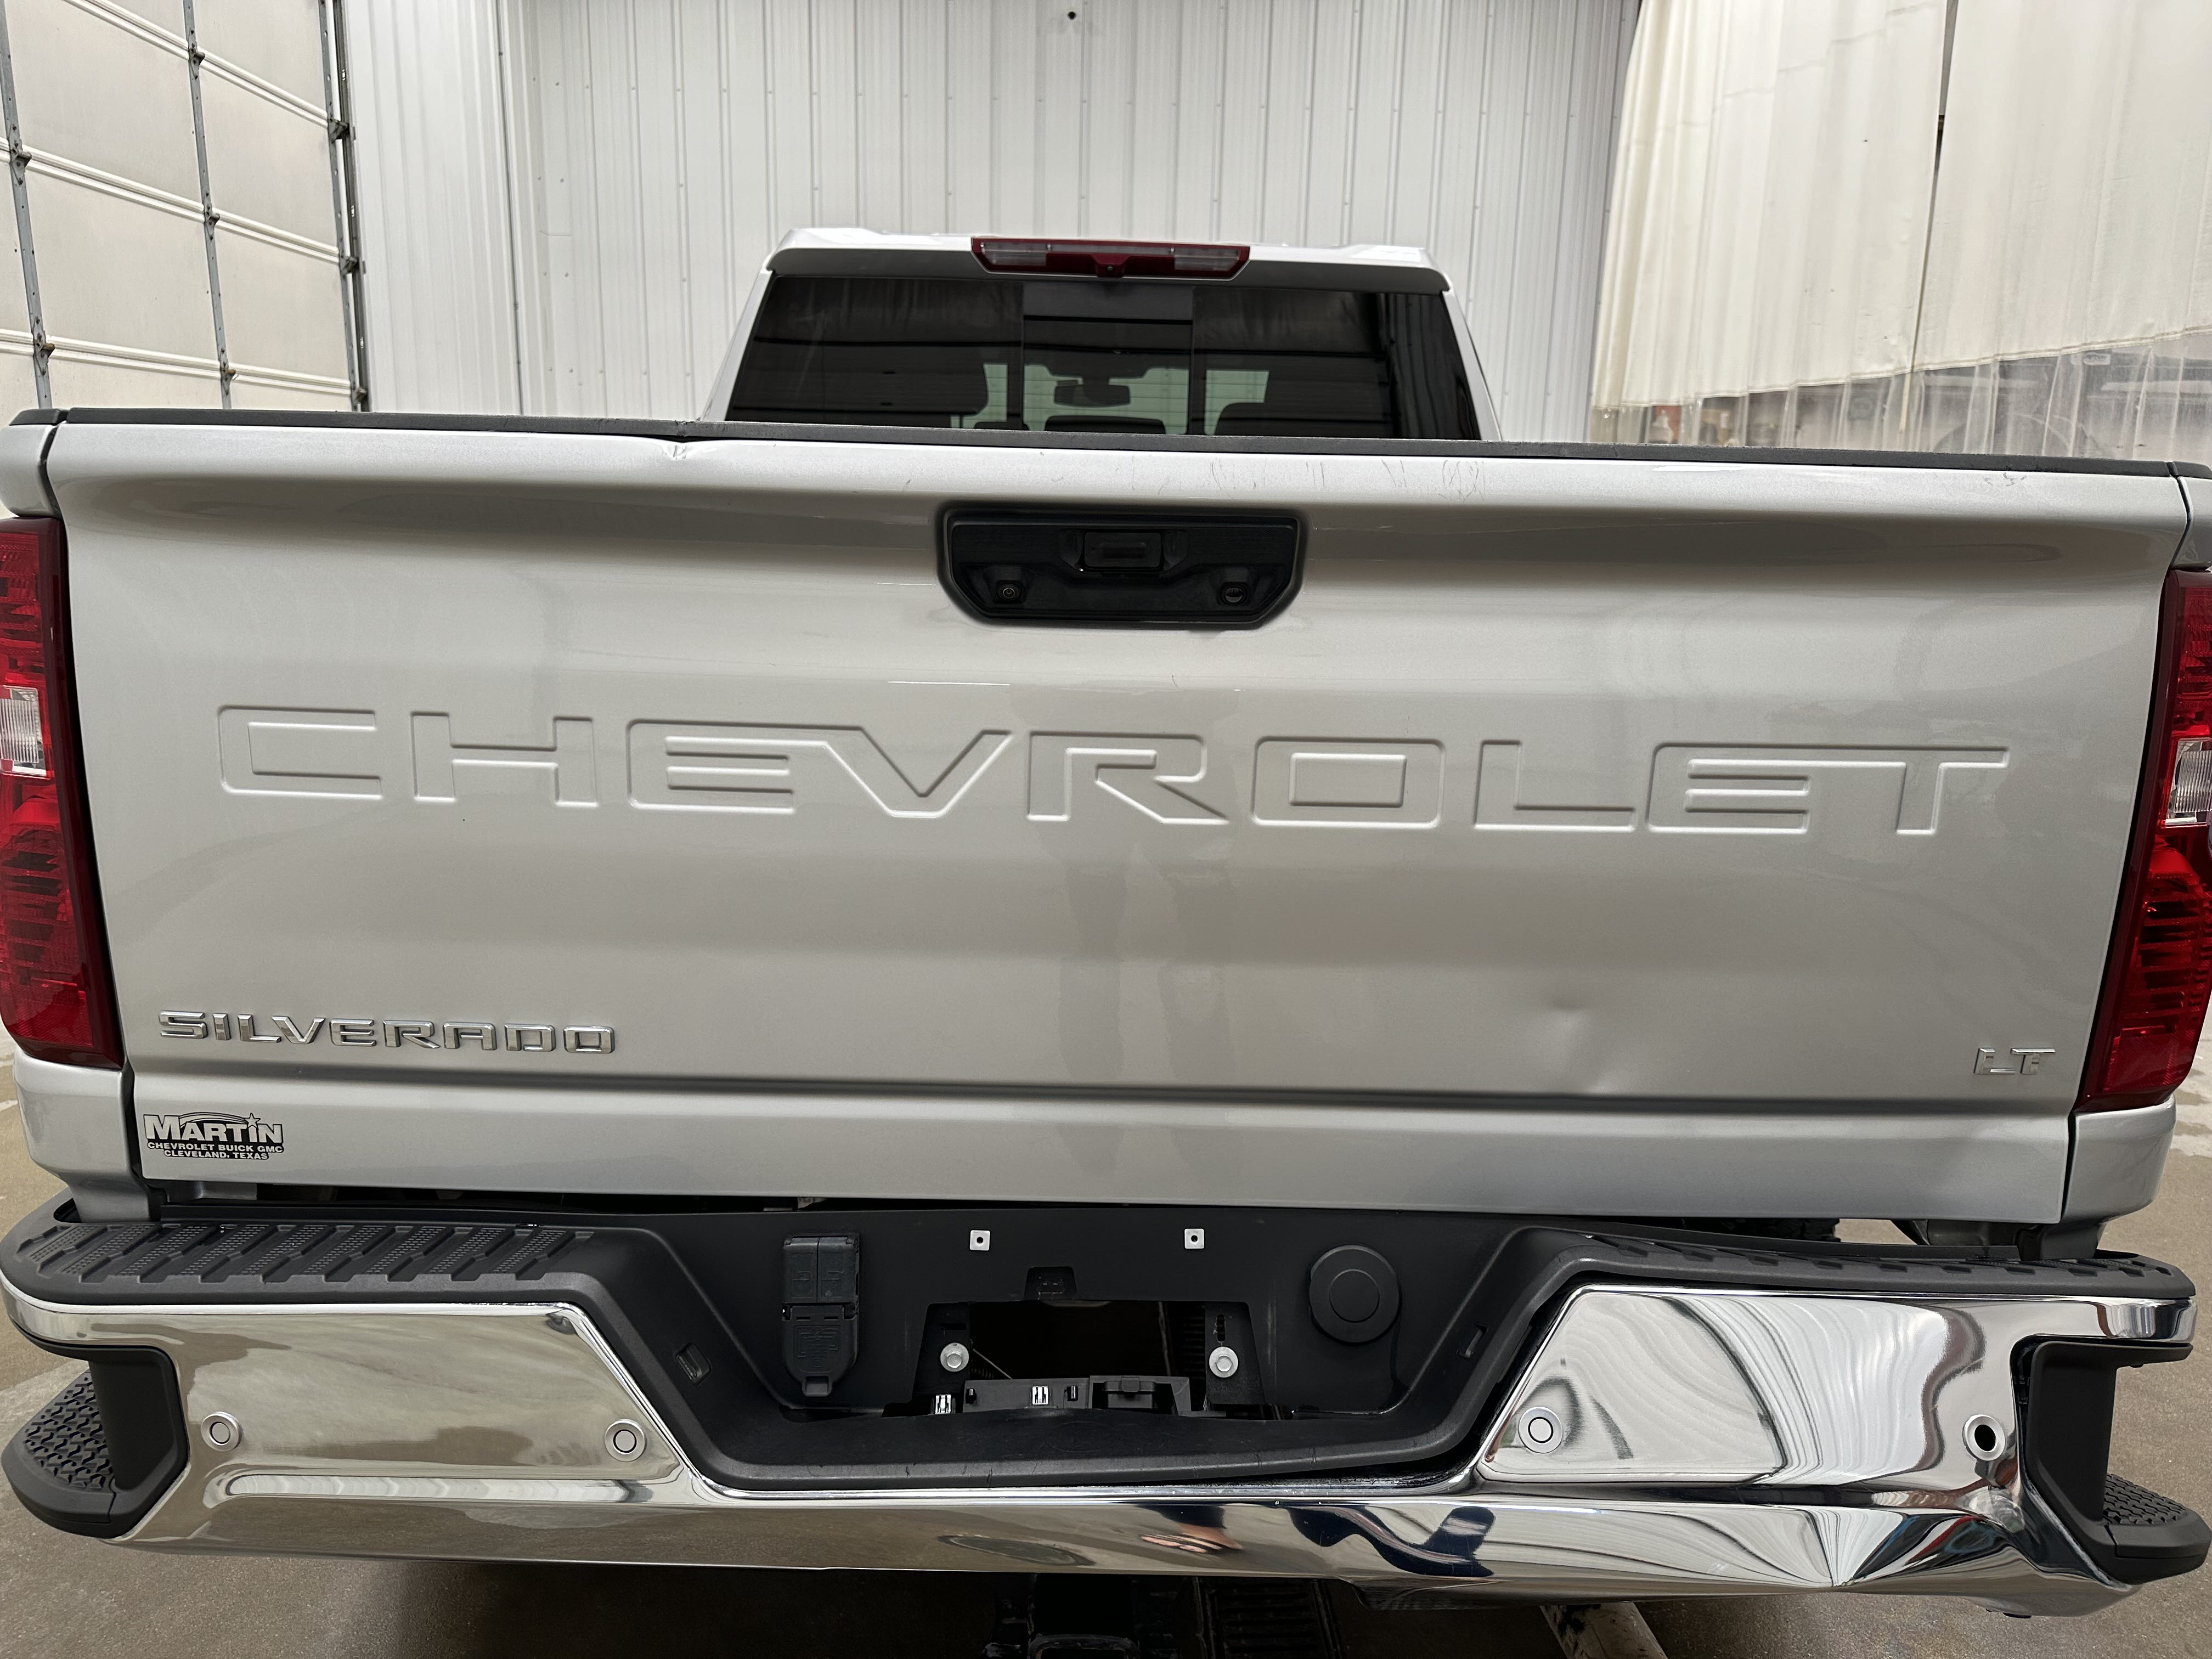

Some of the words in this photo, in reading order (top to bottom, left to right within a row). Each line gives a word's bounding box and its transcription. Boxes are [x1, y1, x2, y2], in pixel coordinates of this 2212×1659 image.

[218, 704, 2009, 836] CHEVROLET
[159, 1011, 616, 1054] SILVERADO
[1974, 1047, 2056, 1075] LT
[148, 1142, 215, 1150] CHEVROLET
[164, 1150, 230, 1159] CLEVELAND,
